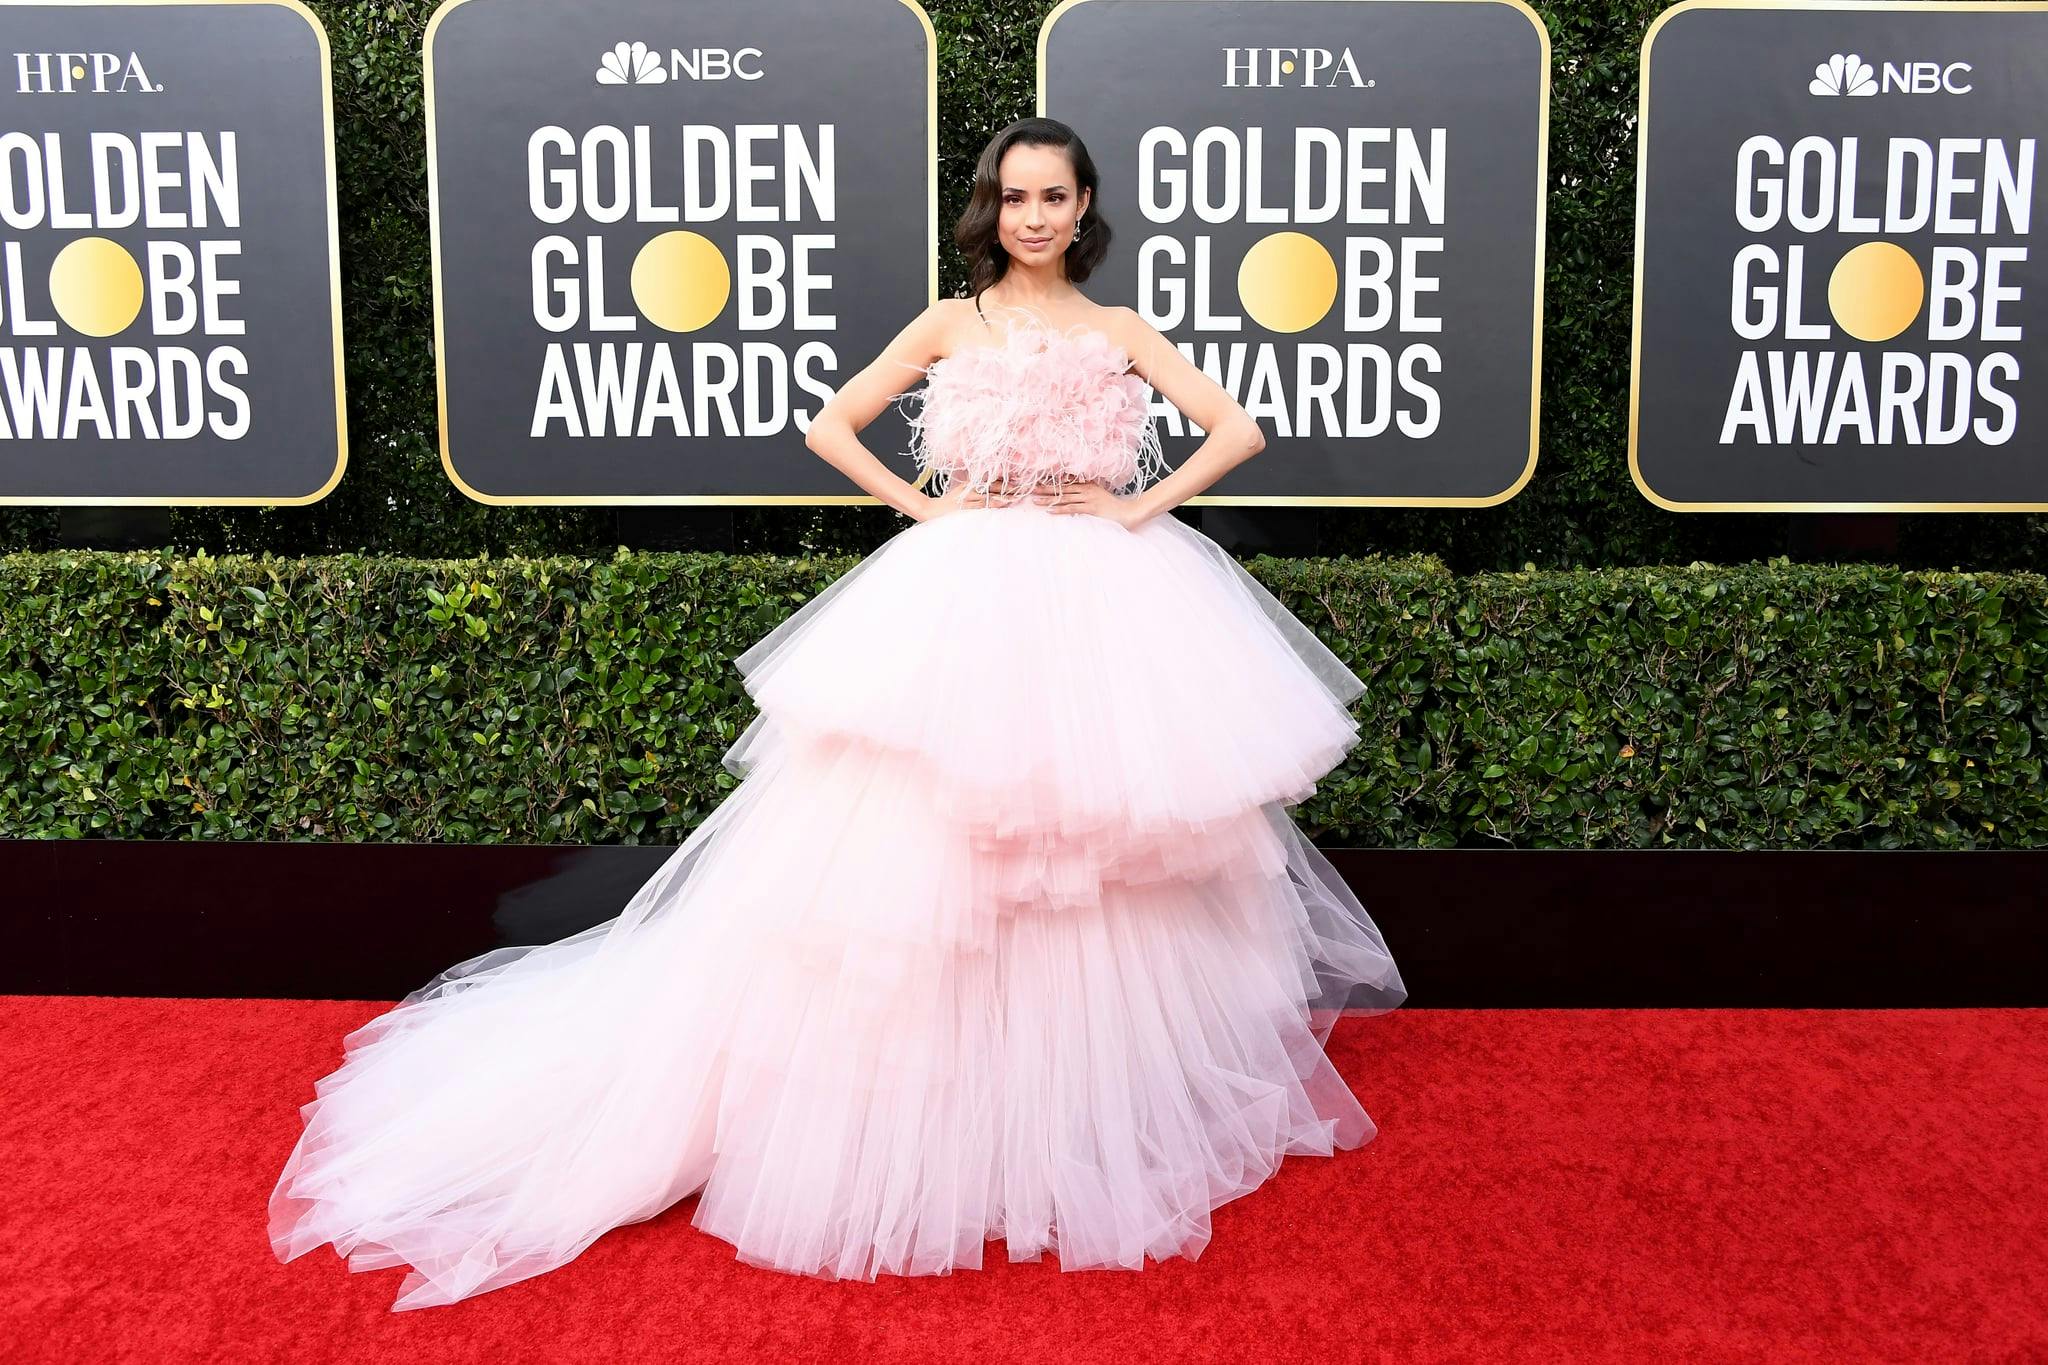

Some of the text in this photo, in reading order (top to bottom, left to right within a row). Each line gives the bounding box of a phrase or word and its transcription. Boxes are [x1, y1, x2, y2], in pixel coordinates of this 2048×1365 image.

[13, 52, 163, 93] HFPA
[671, 48, 764, 81] NBC
[1222, 47, 1375, 88] HFPA
[1882, 62, 1973, 94] NBC
[0, 131, 241, 230] OLDEN
[528, 124, 836, 224] GOLDEN
[1138, 126, 1447, 225] GOLDEN
[1736, 135, 2036, 235] GOLDEN
[0, 236, 246, 338] LOBE
[532, 231, 837, 333] GLOBE
[1138, 232, 1444, 333] GLOBE
[1731, 242, 2028, 341] GLOBE
[0, 346, 251, 441] WARDS
[531, 341, 838, 437] AWARDS
[1719, 351, 2020, 446] AWARDS
